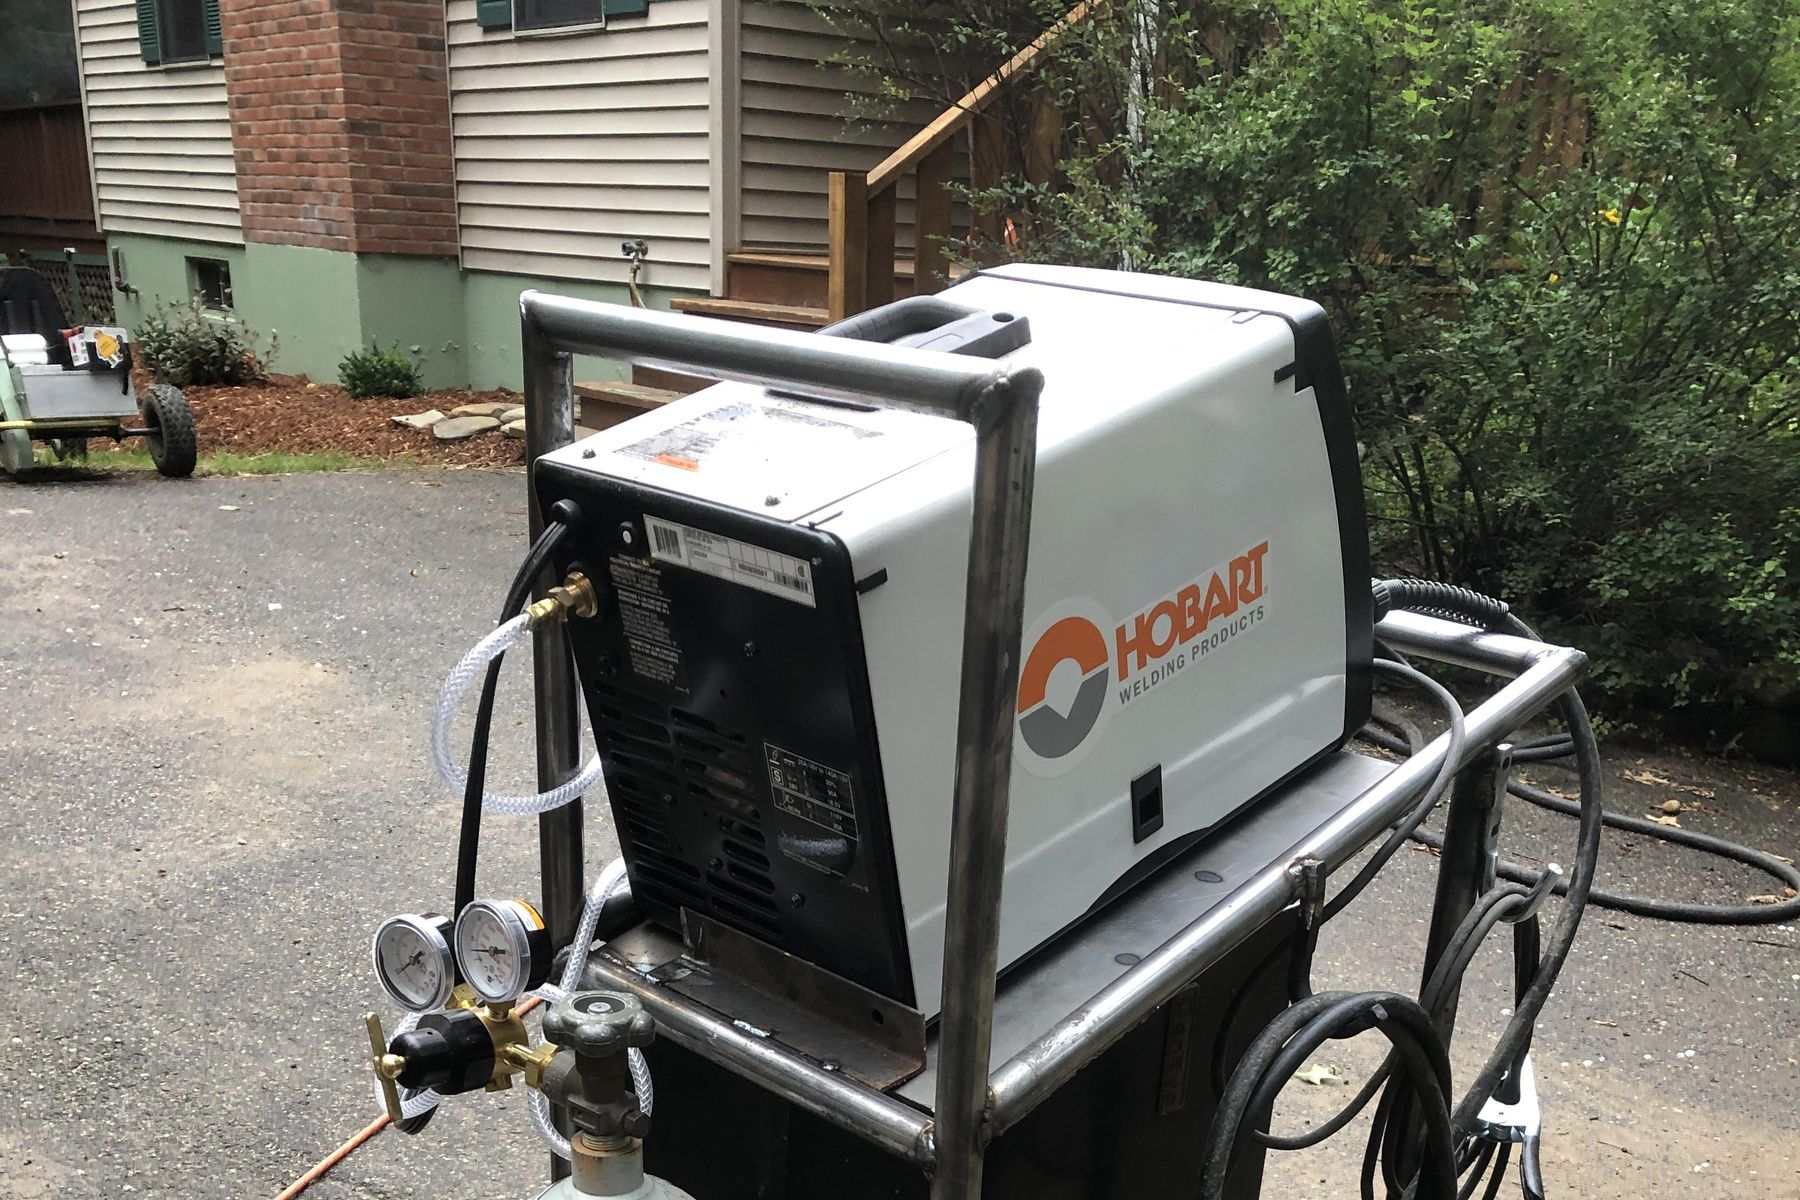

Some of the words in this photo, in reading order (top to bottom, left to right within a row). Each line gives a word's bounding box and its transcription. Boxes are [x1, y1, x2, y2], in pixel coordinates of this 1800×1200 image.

[1115, 540, 1269, 683] HOBART
[1119, 654, 1185, 705] WELDING
[1191, 605, 1264, 661] PRODUCTS
[773, 770, 781, 782] S
